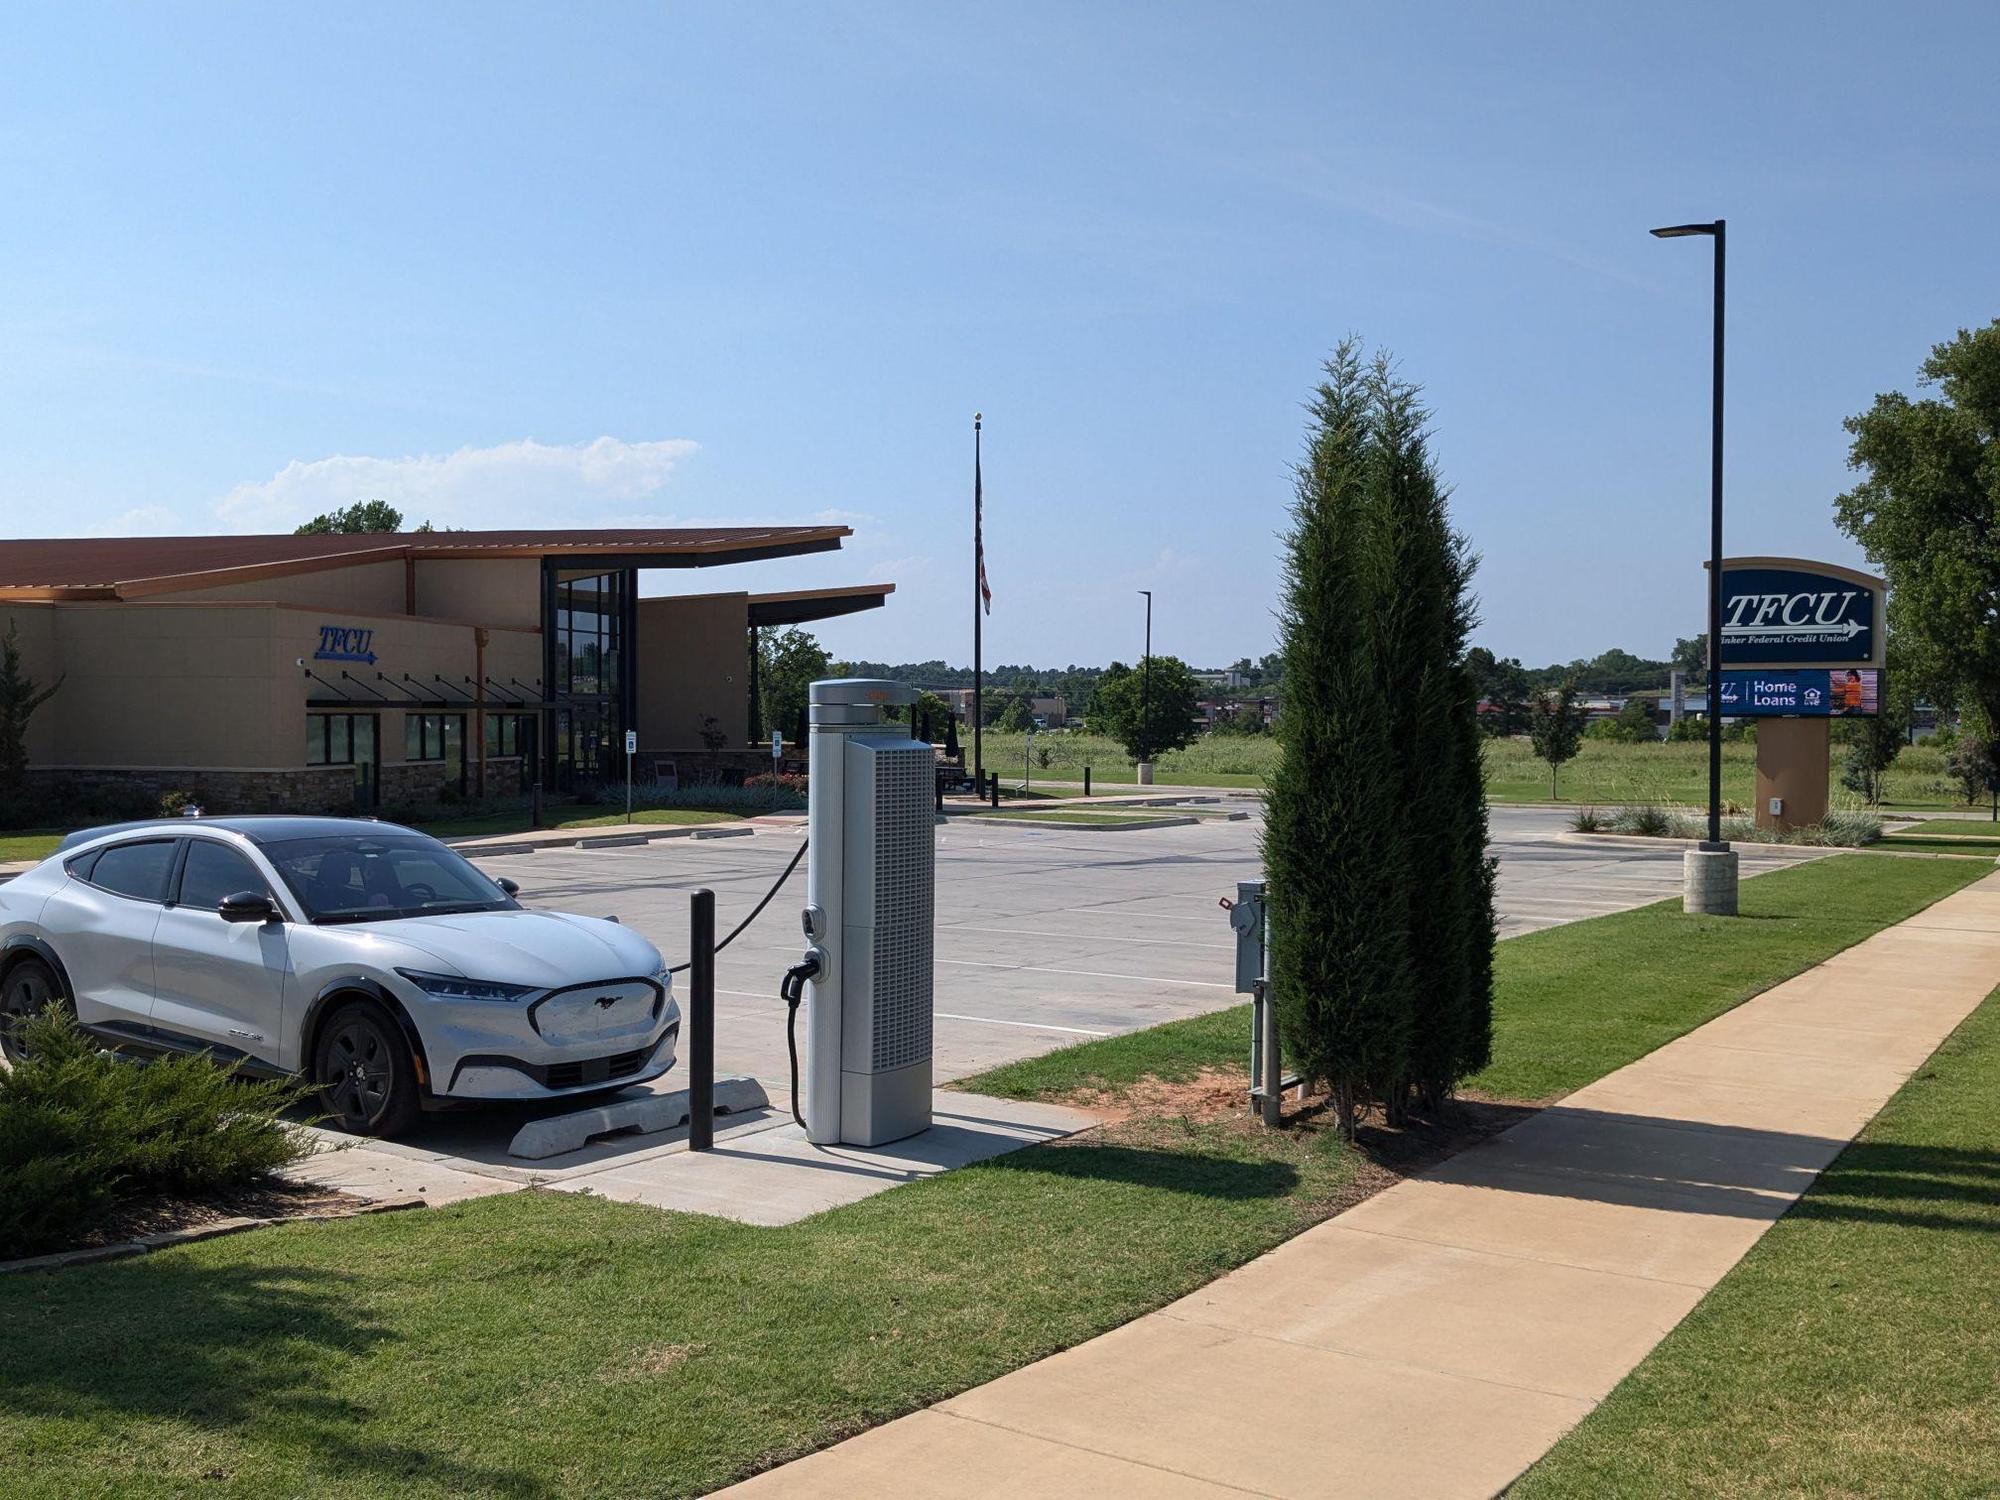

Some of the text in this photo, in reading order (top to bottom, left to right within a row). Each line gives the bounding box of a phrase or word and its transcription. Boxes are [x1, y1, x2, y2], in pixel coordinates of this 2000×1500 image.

[1725, 592, 1857, 627] TFCU
[319, 627, 374, 654] TFCU
[1721, 634, 1849, 645] inker Federal Credit Union
[1754, 680, 1797, 693] Home
[1754, 695, 1796, 706] Loans
